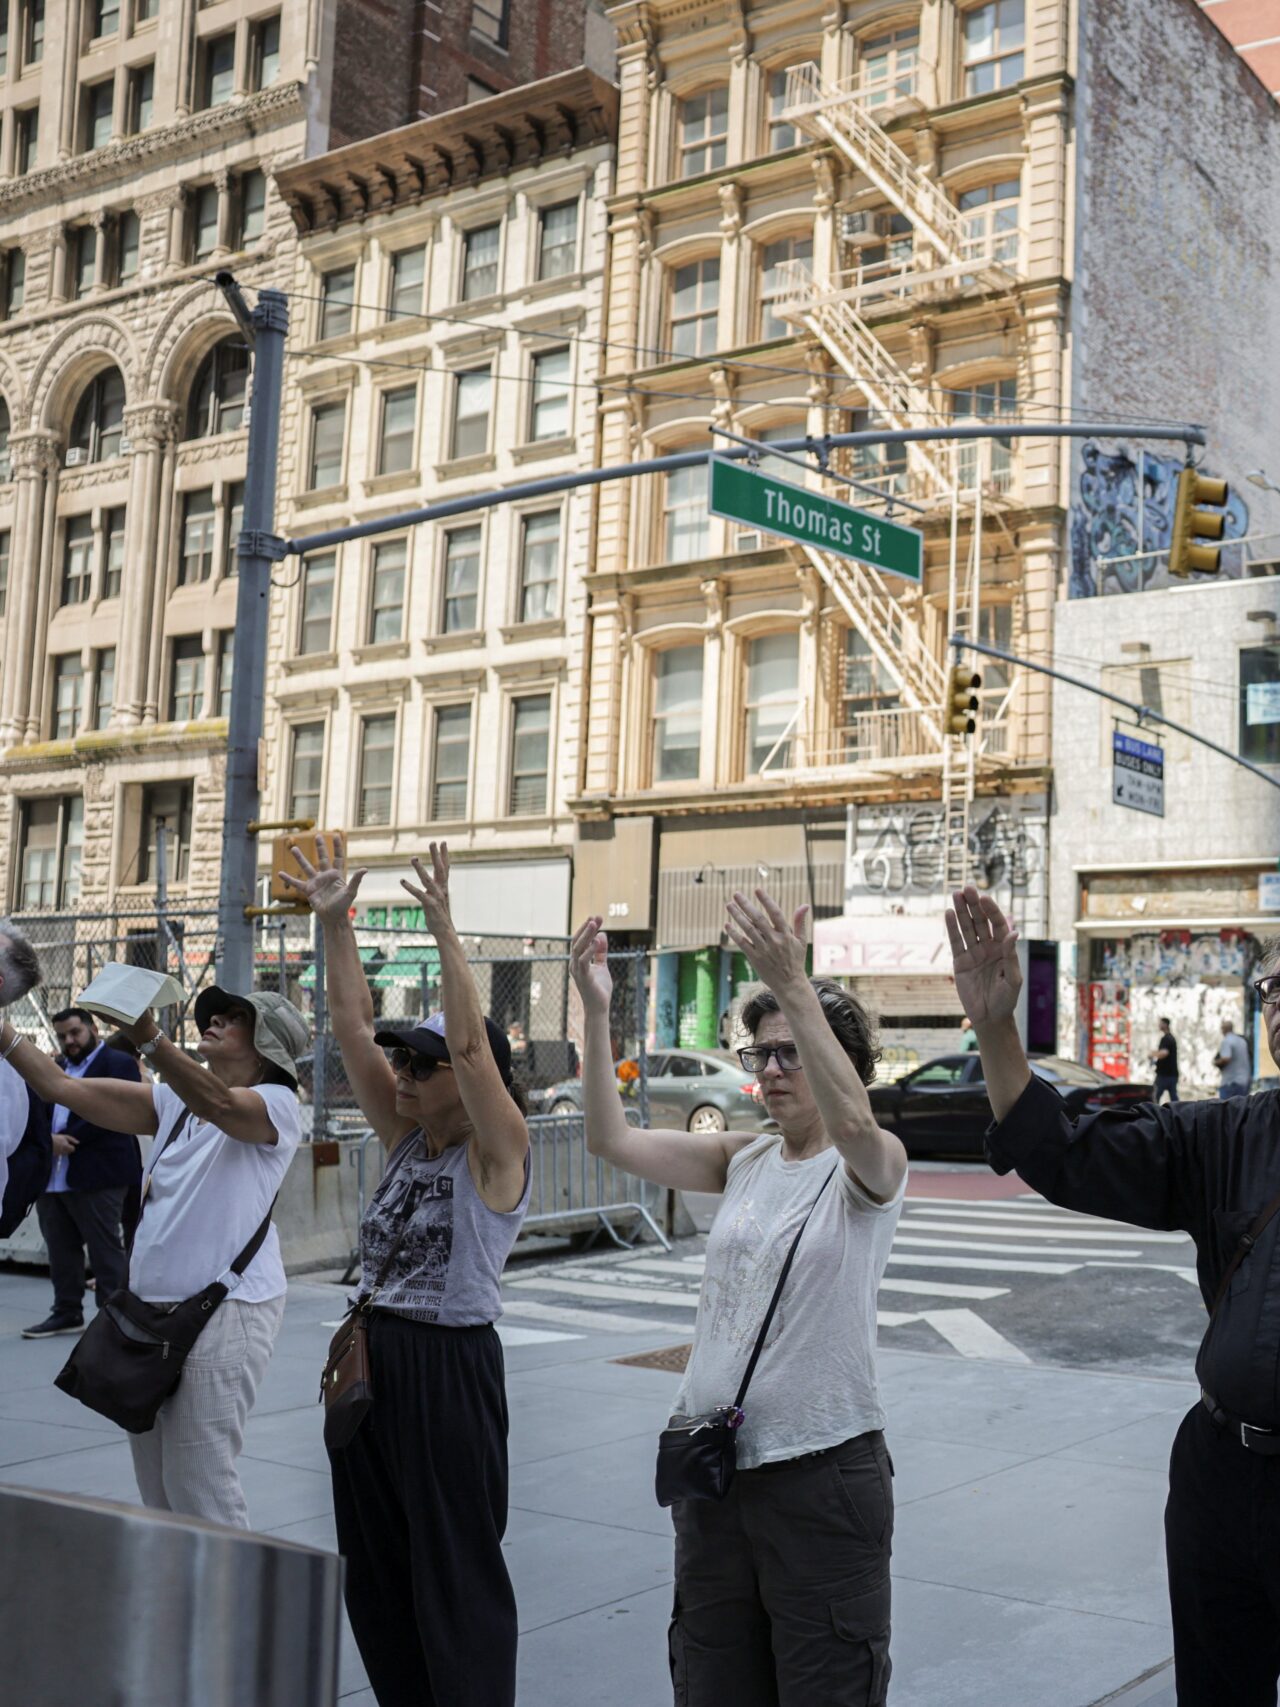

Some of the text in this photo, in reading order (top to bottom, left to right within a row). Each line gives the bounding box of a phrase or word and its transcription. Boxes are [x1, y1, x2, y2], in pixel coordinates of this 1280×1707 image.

[764, 488, 881, 557] Thomas St
[441, 1181, 452, 1191] ST
[404, 1279, 427, 1291] GROCERY
[427, 1279, 446, 1292] STORES
[392, 1294, 405, 1304] BANK
[412, 1295, 425, 1305] POST
[424, 1295, 443, 1307] OFFICE
[415, 1309, 440, 1321] SYSTEM
